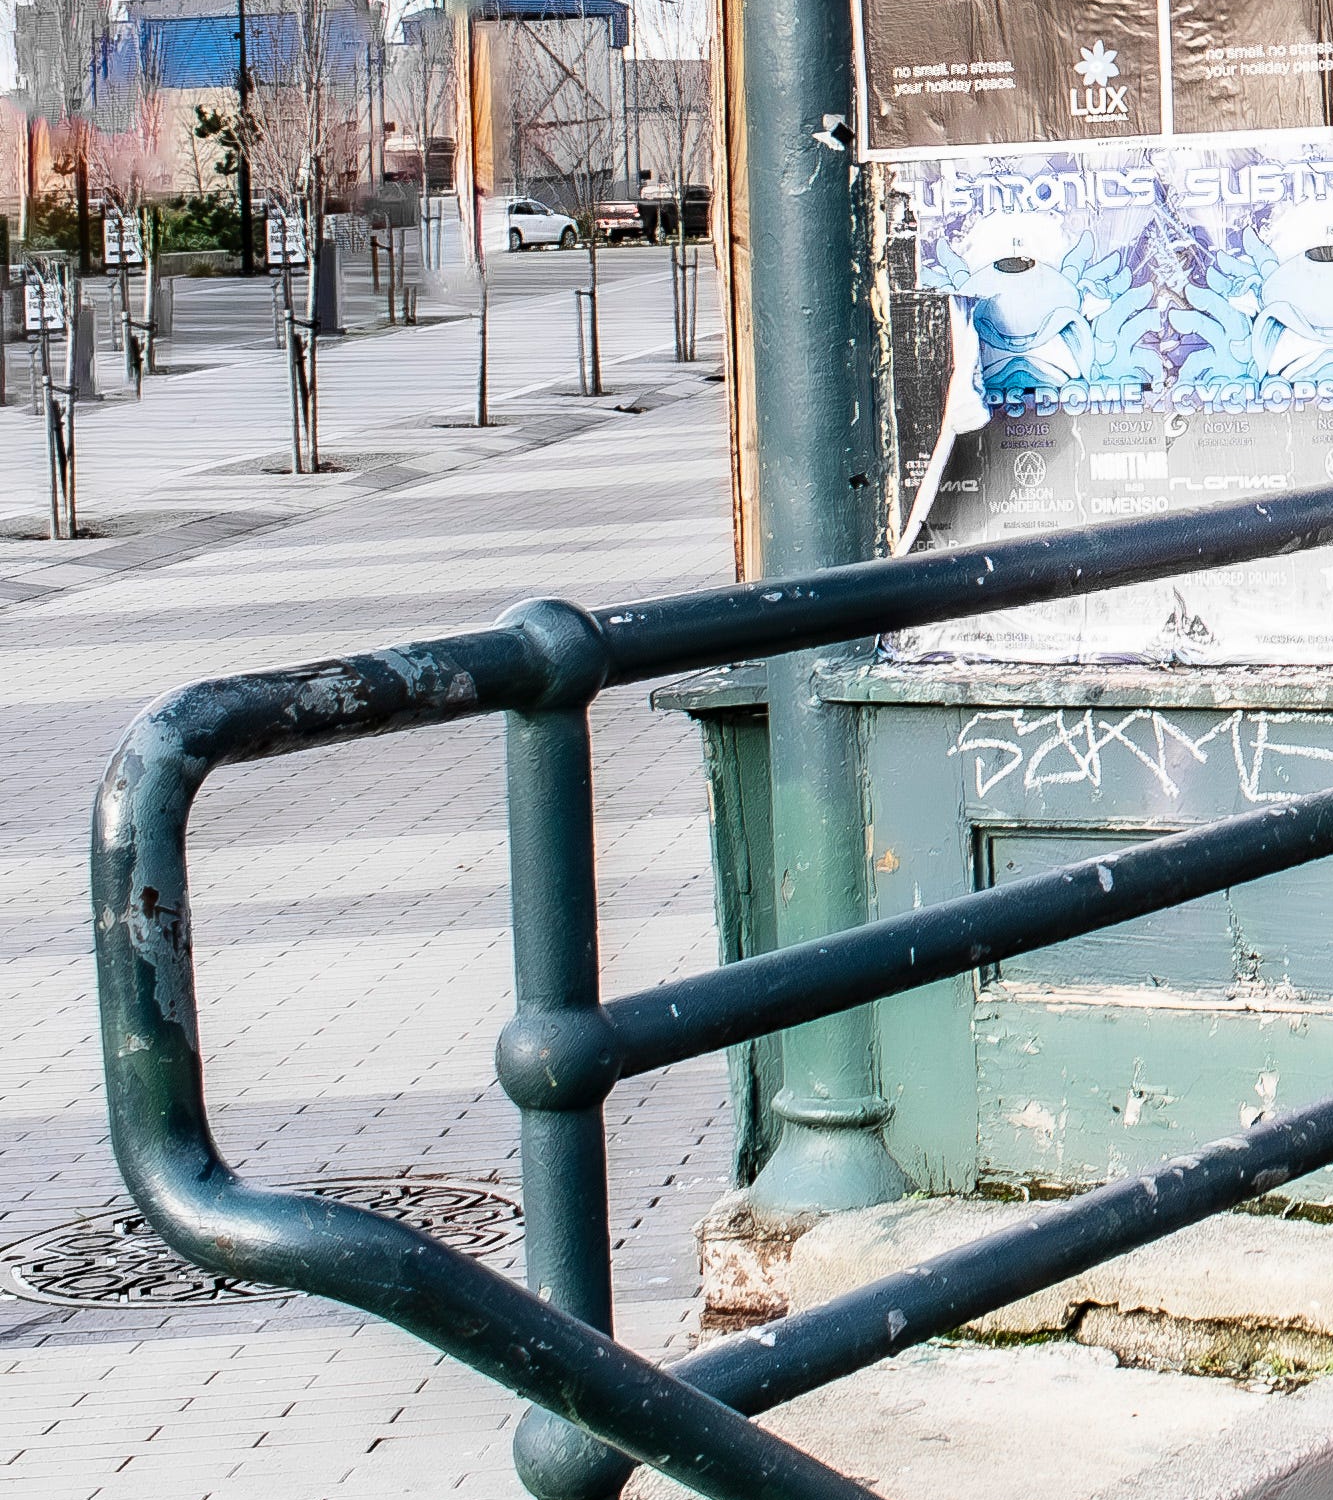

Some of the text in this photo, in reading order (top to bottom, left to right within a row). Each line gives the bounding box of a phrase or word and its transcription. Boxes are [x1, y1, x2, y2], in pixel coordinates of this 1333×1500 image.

[1240, 61, 1290, 76] holiday
[925, 78, 972, 94] holiday
[1070, 86, 1128, 116] LUX
[903, 167, 1162, 217] UBTRONICS
[1010, 488, 1055, 500] ALISON
[989, 500, 1075, 514] WONDERLAND
[1248, 570, 1288, 585] DRUMS
